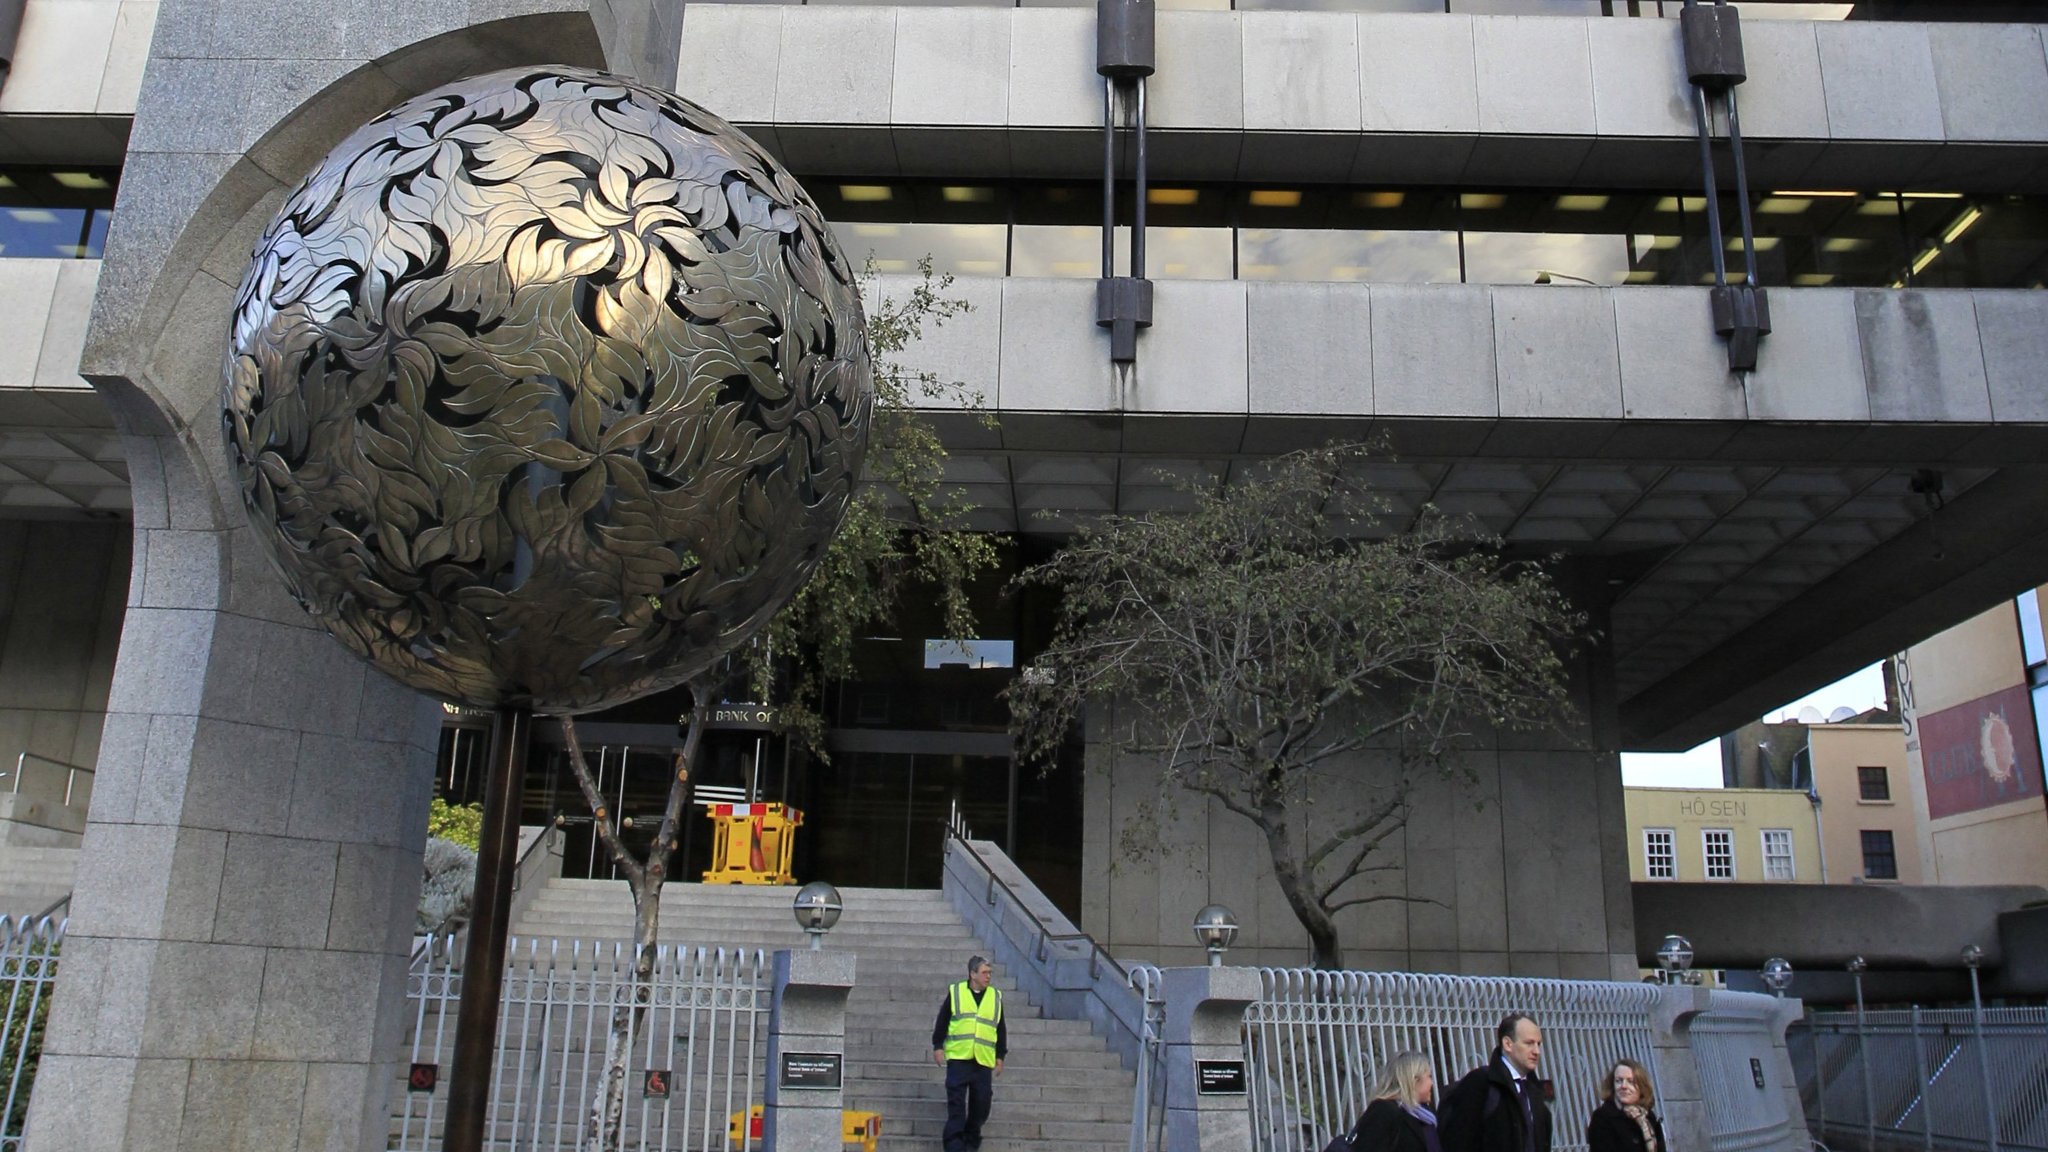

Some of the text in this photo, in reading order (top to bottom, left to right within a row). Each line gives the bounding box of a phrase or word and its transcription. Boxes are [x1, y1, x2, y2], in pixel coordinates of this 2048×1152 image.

[716, 710, 749, 722] BANK
[1928, 742, 1977, 785] CLUB
[1710, 800, 1747, 817] SEN
